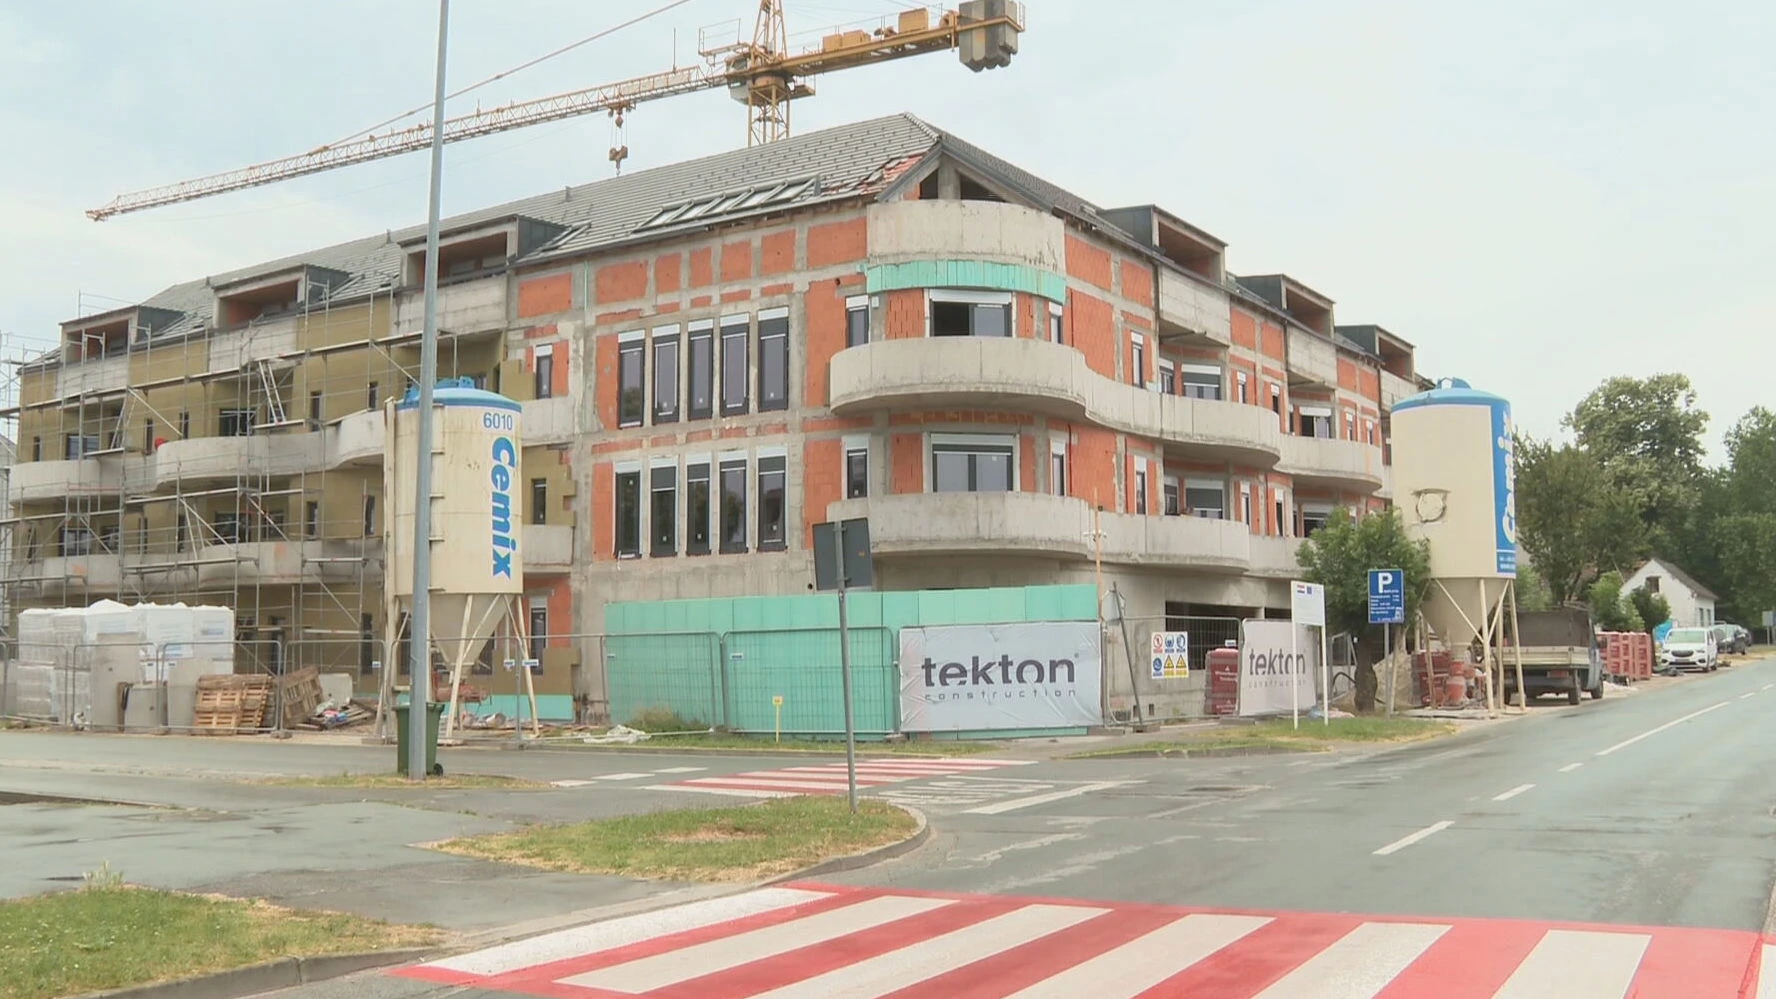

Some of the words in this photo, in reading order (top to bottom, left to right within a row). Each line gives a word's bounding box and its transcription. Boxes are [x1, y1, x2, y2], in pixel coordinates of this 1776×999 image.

[483, 412, 513, 430] 6010
[490, 436, 516, 579] Cemix
[1378, 572, 1393, 593] P
[920, 653, 1076, 688] tekton
[924, 689, 1076, 701] construction
